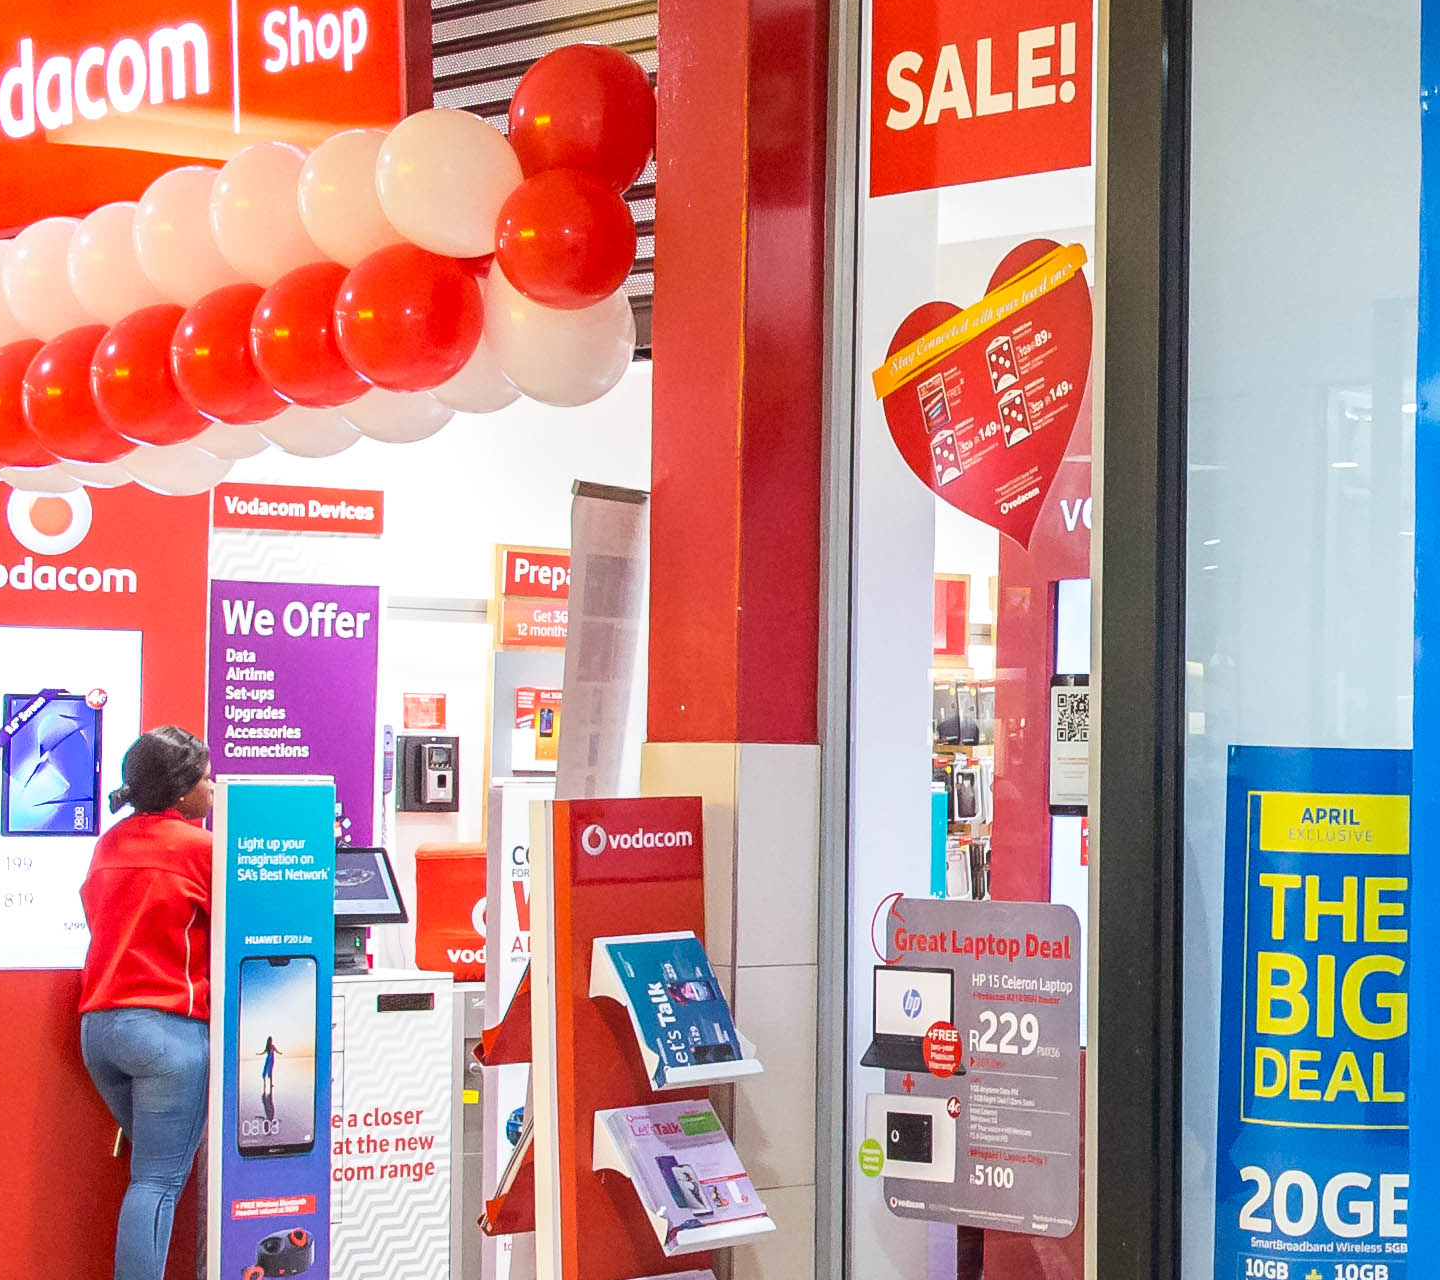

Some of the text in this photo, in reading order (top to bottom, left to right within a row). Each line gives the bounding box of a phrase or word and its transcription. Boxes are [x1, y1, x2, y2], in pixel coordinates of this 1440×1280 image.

[263, 5, 369, 73] Shop
[885, 21, 1077, 131] SALE!
[224, 495, 375, 521] Vodacom Devices
[222, 599, 371, 639] We Offer
[533, 609, 551, 623] Get
[517, 623, 527, 636] 12
[225, 648, 257, 663] Data
[225, 666, 275, 681] Airtime
[225, 685, 275, 704] Set-ups
[224, 705, 286, 723] Upgrades
[224, 724, 302, 739] Accessories
[224, 742, 310, 758] Connections
[1301, 807, 1360, 825] APRIL
[237, 837, 306, 852] Light up your
[608, 827, 693, 850] vodacom
[1287, 827, 1374, 842] EXCLUSIVE
[237, 853, 314, 868] imagination on
[237, 868, 258, 881] SA's
[260, 868, 283, 881] Best
[1258, 873, 1408, 943] THE
[244, 935, 282, 945] HUAWEI
[893, 927, 1071, 963] Great Laptop Deal
[971, 973, 1073, 995] HP 15 Celeron Laptop
[647, 982, 676, 1028] Talk
[1256, 951, 1408, 1040] BIG
[969, 1010, 1040, 1056] R229
[667, 1029, 691, 1068] et's
[1253, 1046, 1405, 1102] DEAL
[347, 1107, 425, 1128] a closer
[333, 1134, 435, 1155] at the new
[379, 1161, 436, 1182] range
[969, 1164, 1014, 1189] R5100
[1250, 1236, 1408, 1254] SmartBroadband Wireless 5GB
[1244, 1257, 1289, 1280] 10GB
